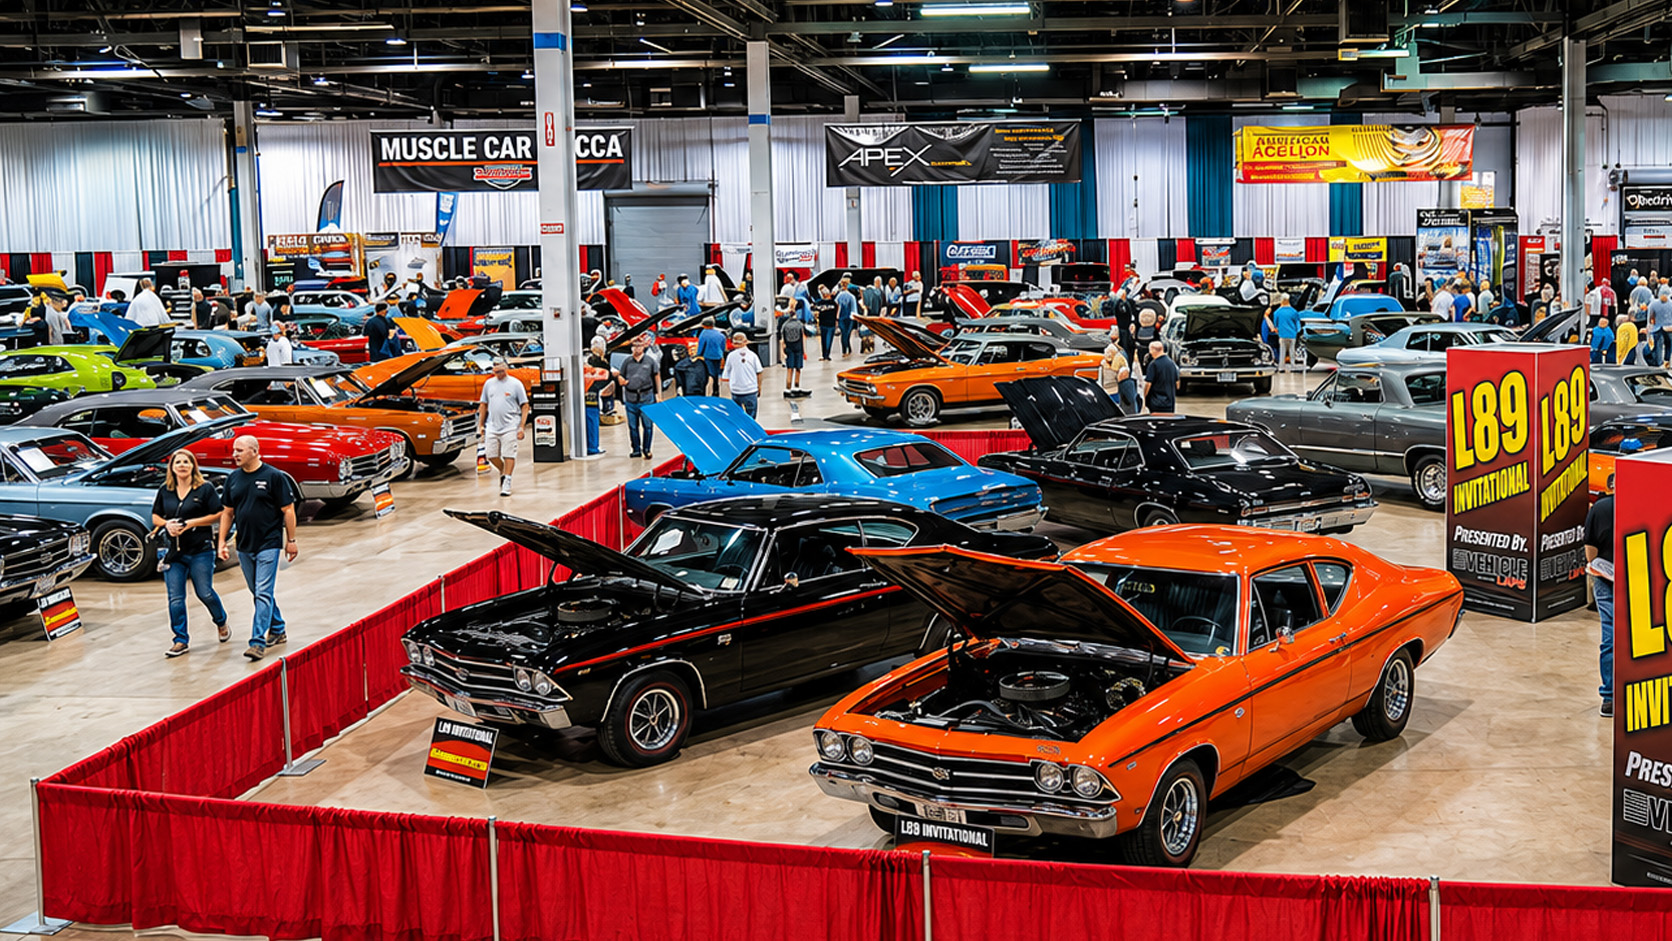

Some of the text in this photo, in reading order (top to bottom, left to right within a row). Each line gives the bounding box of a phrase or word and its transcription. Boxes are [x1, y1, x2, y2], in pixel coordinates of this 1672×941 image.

[381, 135, 624, 160] MUSCLE CAR CCA
[838, 144, 932, 177] APEX
[1452, 371, 1529, 470] L89
[1541, 366, 1586, 475] L89
[1453, 461, 1530, 515] INVITATIONAL
[1454, 525, 1510, 549] PRESENTED
[1626, 524, 1672, 658] L
[1626, 676, 1672, 732] INVI
[1625, 751, 1672, 788] PRES
[922, 823, 988, 847] INVITATIONAL
